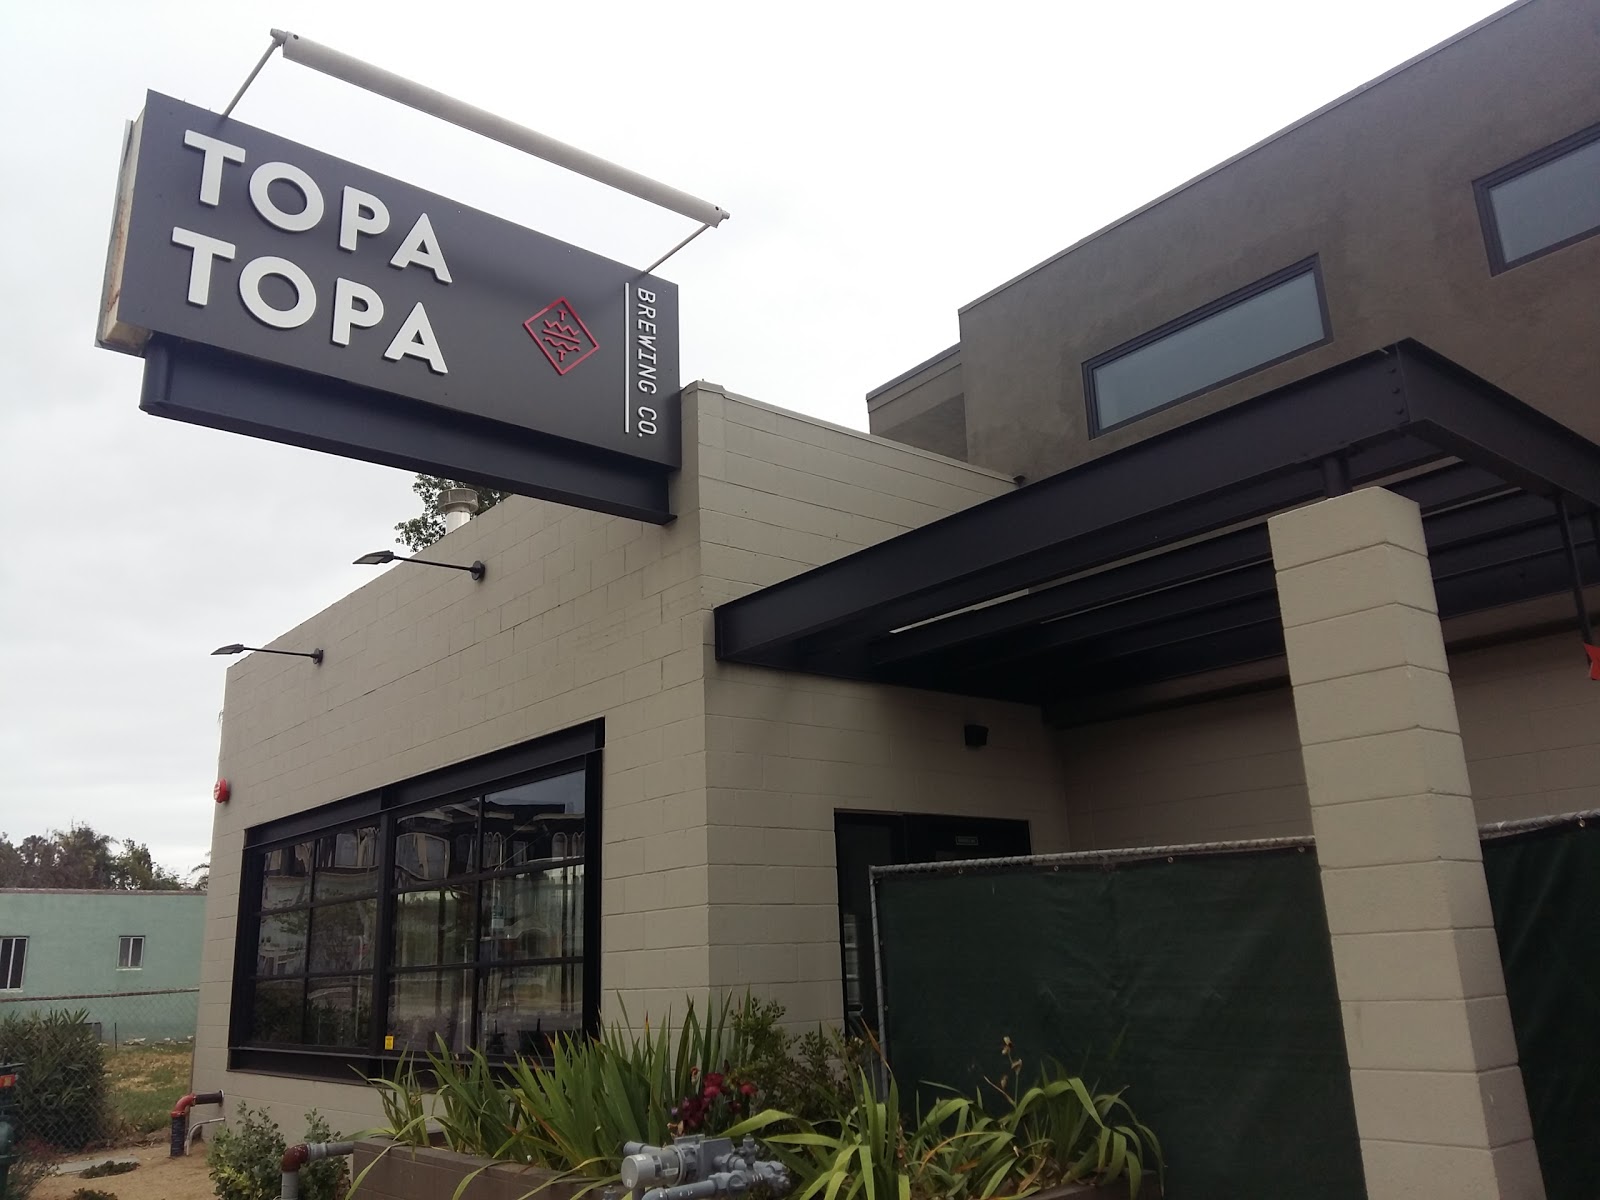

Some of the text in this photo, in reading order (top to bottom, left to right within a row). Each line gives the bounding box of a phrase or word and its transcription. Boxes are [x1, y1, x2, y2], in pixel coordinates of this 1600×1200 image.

[184, 129, 453, 284] TOPA
[171, 226, 449, 374] TOPA
[637, 287, 658, 438] BREWING CO.
